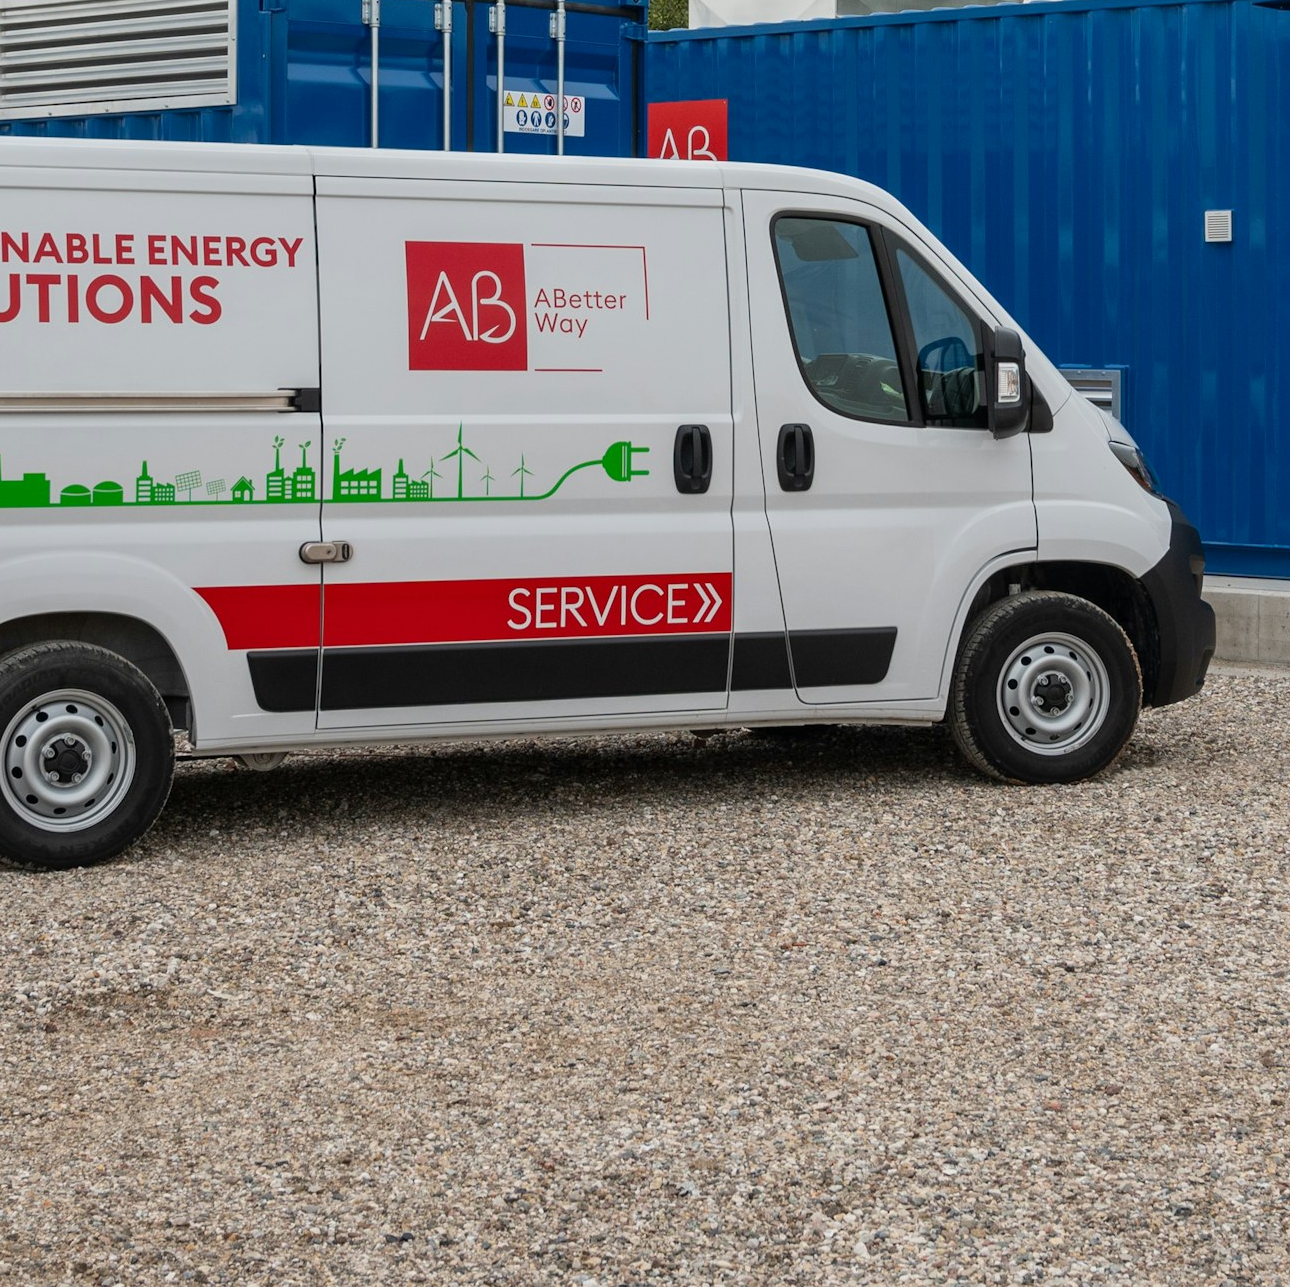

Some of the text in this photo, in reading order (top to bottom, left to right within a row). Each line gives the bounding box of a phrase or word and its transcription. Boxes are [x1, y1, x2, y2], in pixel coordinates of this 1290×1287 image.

[148, 234, 304, 267] ENERGY
[419, 270, 517, 344] AB
[534, 288, 627, 310] ABetter
[534, 312, 588, 339] Way
[507, 583, 689, 630] SERVICE
